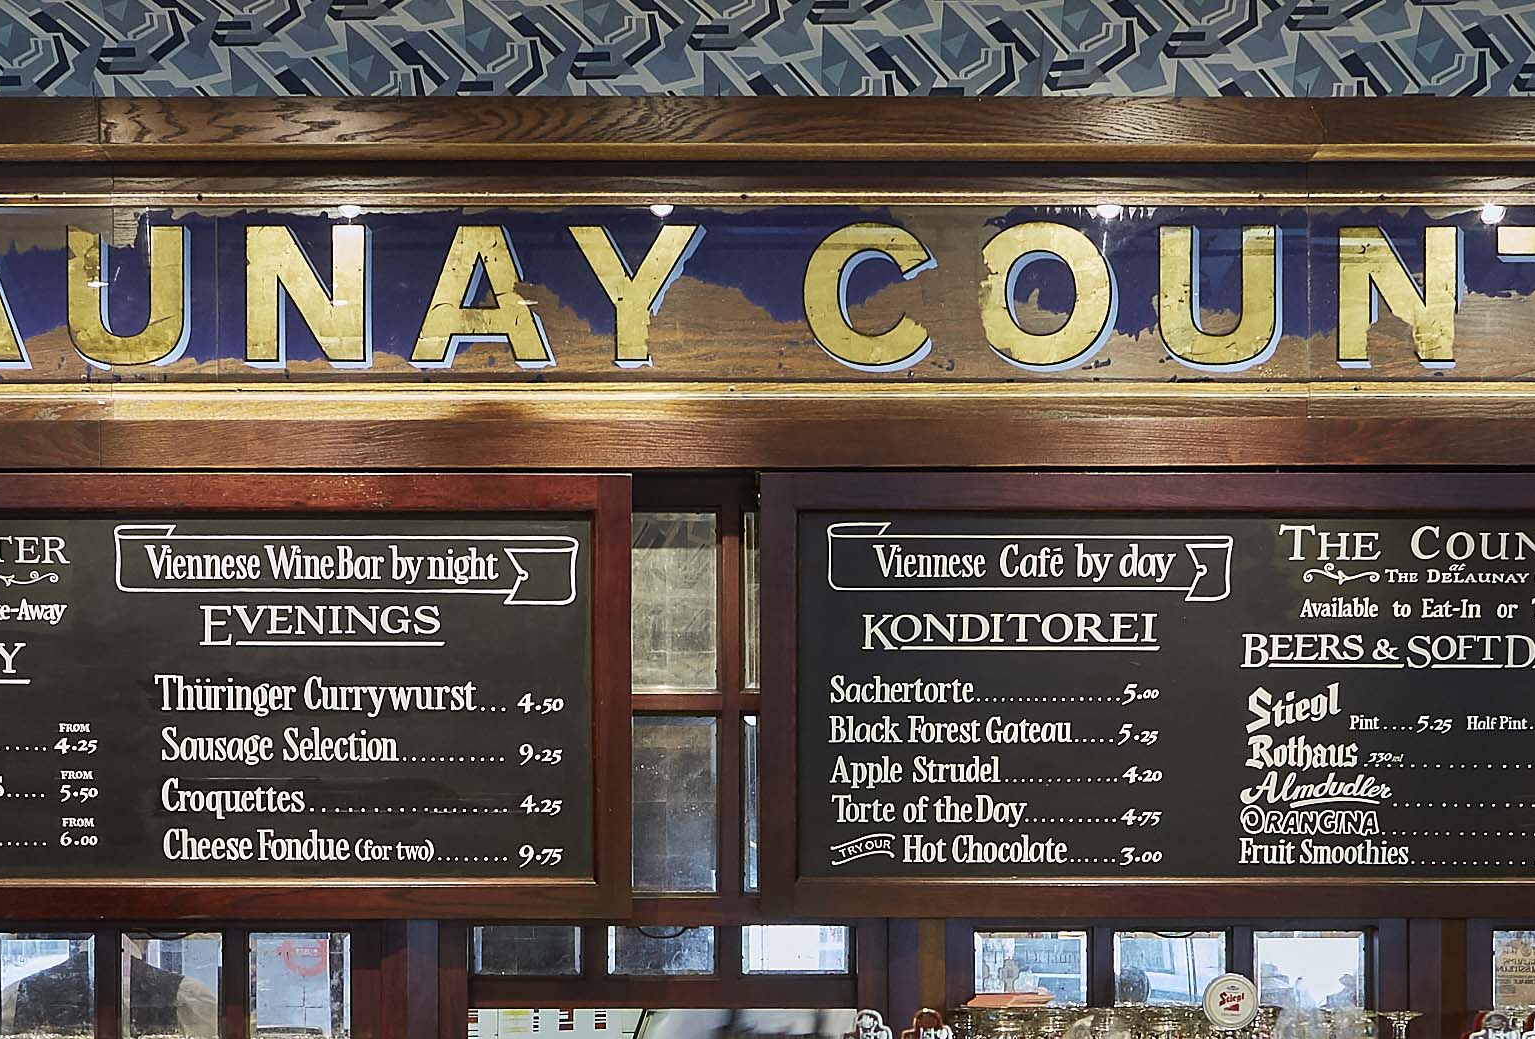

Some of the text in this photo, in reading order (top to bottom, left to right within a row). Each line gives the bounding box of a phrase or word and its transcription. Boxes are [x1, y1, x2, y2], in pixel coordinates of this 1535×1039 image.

[1278, 523, 1382, 561] THE
[199, 604, 446, 647] EVENINGS
[861, 612, 1161, 651] KONDITOREI
[1240, 633, 1365, 668] BEERS
[1371, 638, 1400, 661] &
[1406, 634, 1504, 669] SOFT
[153, 673, 565, 718] Thüringer Currywurst 4.50
[830, 674, 1160, 706] Sachertorte 5.00
[1245, 682, 1342, 734] Stiegl
[1348, 714, 1381, 730] Pint
[1416, 715, 1453, 734] 5.25
[1498, 715, 1528, 730] Pint
[58, 722, 91, 733] FROM
[828, 715, 1159, 746] Black Forest Gateau 5.25
[53, 737, 98, 755] 4.25
[161, 726, 563, 766] Sausage Selection 9.25
[1245, 735, 1359, 772] Rothaus
[59, 770, 94, 780] FROM
[828, 755, 1163, 789] Apple Strudel 4.20
[1240, 770, 1393, 806] Almdudler
[59, 784, 99, 804] 5.50
[161, 777, 563, 820] Croquettes 4.25
[831, 793, 896, 823] Torte
[902, 795, 930, 824] of
[1120, 808, 1163, 827] 4.75
[61, 817, 95, 828] FROM
[1240, 805, 1380, 836] ORANGINA
[59, 831, 99, 847] 6.00
[163, 828, 254, 861] Cheese
[256, 828, 351, 861] Fondue
[518, 844, 564, 868] 9.75
[902, 833, 1163, 866] Hot Chocolate 3.00
[1238, 837, 1296, 865] Fruit
[1299, 838, 1409, 865] Smoothies
